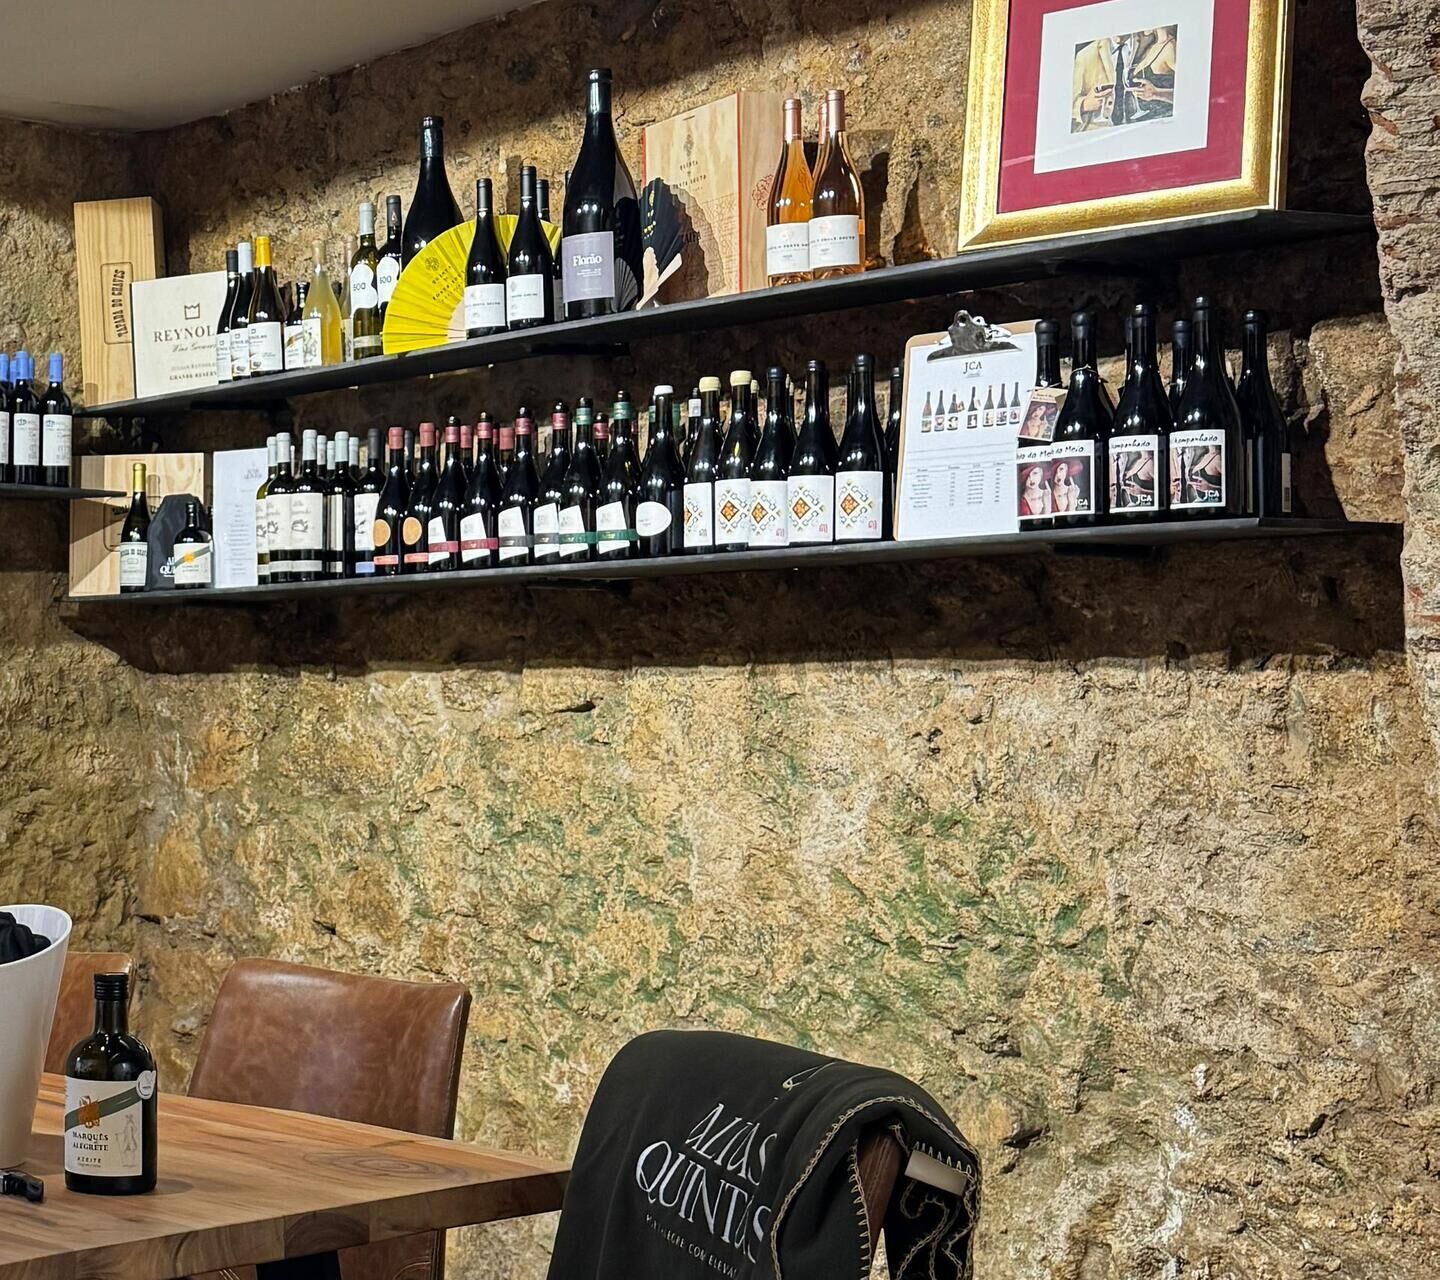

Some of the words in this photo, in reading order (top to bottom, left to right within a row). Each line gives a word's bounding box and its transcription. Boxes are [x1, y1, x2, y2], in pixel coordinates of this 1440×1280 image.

[153, 325, 216, 343] REYNOL
[962, 361, 982, 375] JCA
[1135, 494, 1153, 505] JCA
[1201, 489, 1220, 500] JCA
[635, 1140, 772, 1265] QUINTAS
